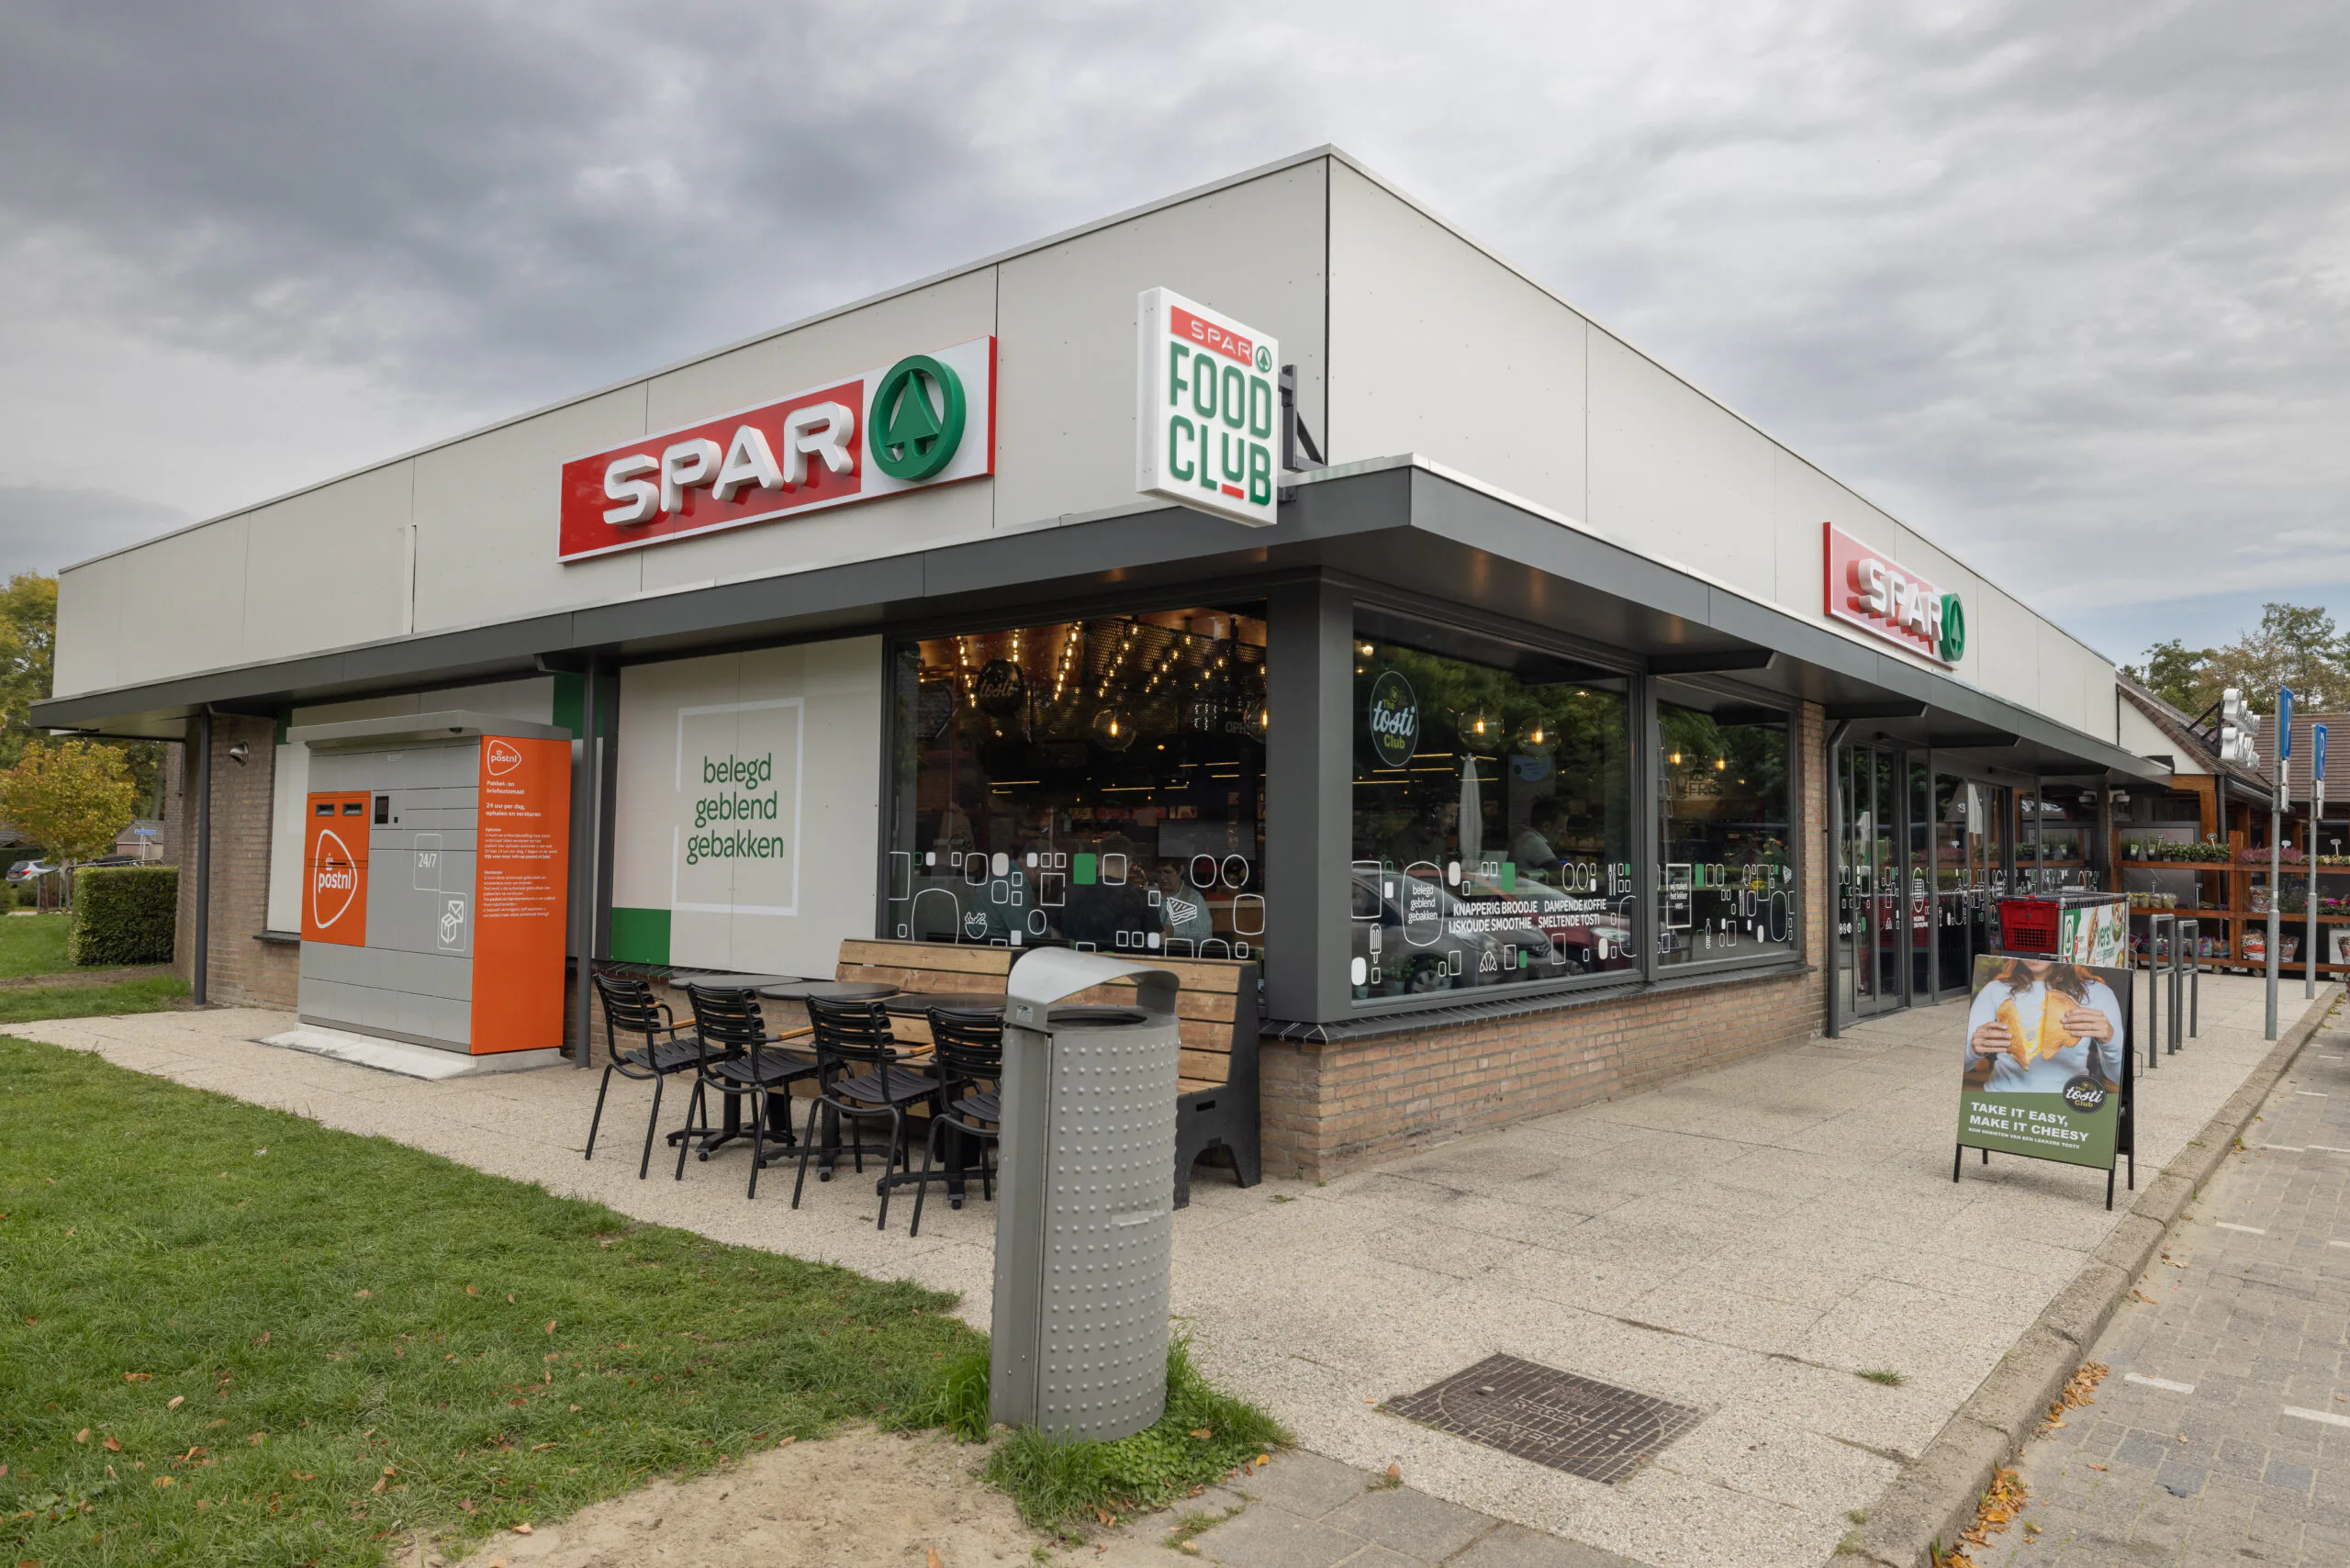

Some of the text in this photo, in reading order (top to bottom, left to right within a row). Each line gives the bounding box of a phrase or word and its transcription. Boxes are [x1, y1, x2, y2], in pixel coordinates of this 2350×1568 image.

[1191, 319, 1251, 361] SPAR
[1169, 341, 1272, 440] FOOD
[603, 400, 855, 526] SPAR
[1169, 414, 1271, 506] CLUB
[1858, 558, 1943, 642] SPAR
[1382, 699, 1395, 710] The
[1372, 700, 1416, 736] tosti
[1383, 734, 1405, 749] Club
[491, 755, 517, 763] postnl
[703, 752, 772, 790] belegd
[695, 790, 778, 828] geblend
[686, 829, 784, 865] gebakken
[419, 853, 438, 868] 24/7
[319, 869, 352, 894] postnl
[1412, 884, 1434, 898] belegd
[1410, 897, 1436, 911] geblend
[1453, 901, 1539, 916] KNAPPERIG BROODJE
[1544, 898, 1606, 913] DAMPENDE KOFFIE
[1407, 911, 1438, 924] gebakken
[1449, 916, 1532, 934] IJSKOUDE SMOOTHIE
[1538, 913, 1600, 929] SMELTENDE TOSTI
[2065, 1086, 2104, 1103] tosti
[2075, 1099, 2094, 1108] Club
[1971, 1102, 2068, 1127] TAKE IT EASY,
[1969, 1114, 2089, 1142] MAKE IT CHEESY
[1981, 1128, 2009, 1137] GENIETEN
[2034, 1137, 2061, 1147] LEKKERE
